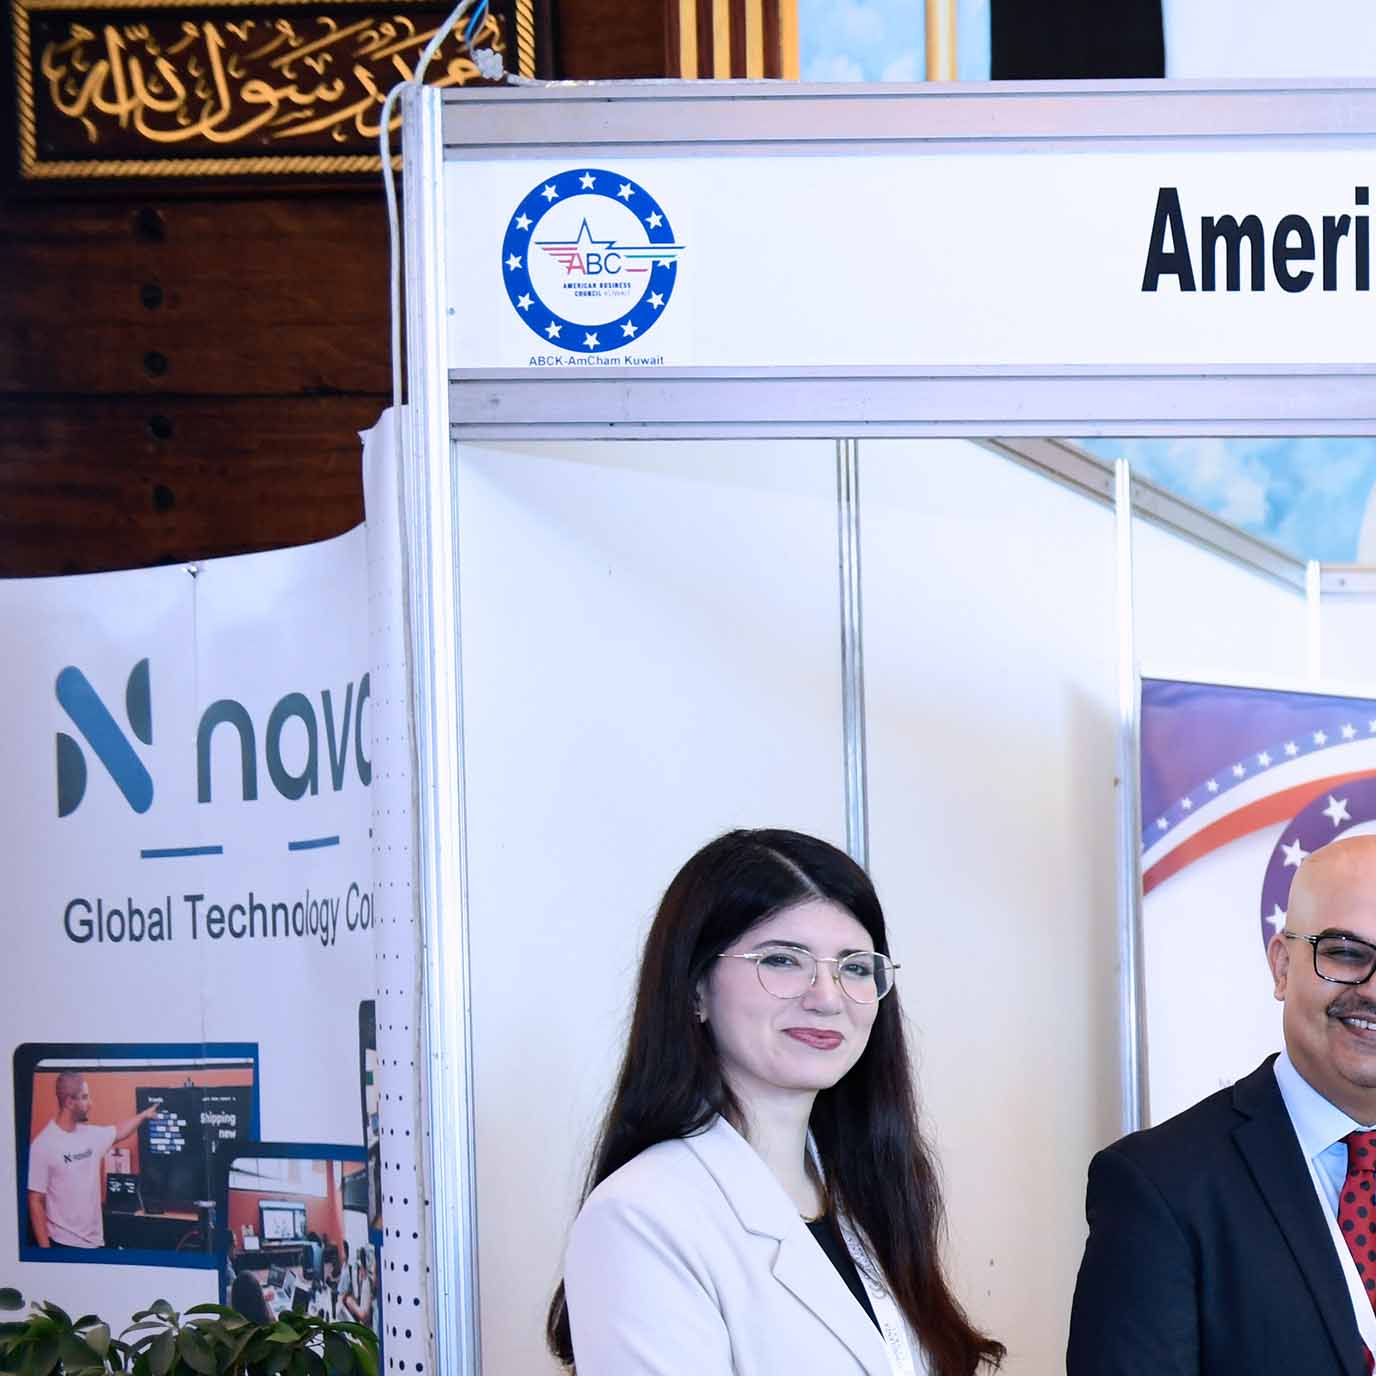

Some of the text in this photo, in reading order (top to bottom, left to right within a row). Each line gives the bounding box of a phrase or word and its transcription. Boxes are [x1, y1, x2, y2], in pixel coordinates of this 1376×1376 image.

[566, 253, 622, 275] ABC
[529, 355, 664, 367] ABCK-AmCham Kuwait
[64, 897, 173, 944] Global
[184, 887, 340, 947] Technology
